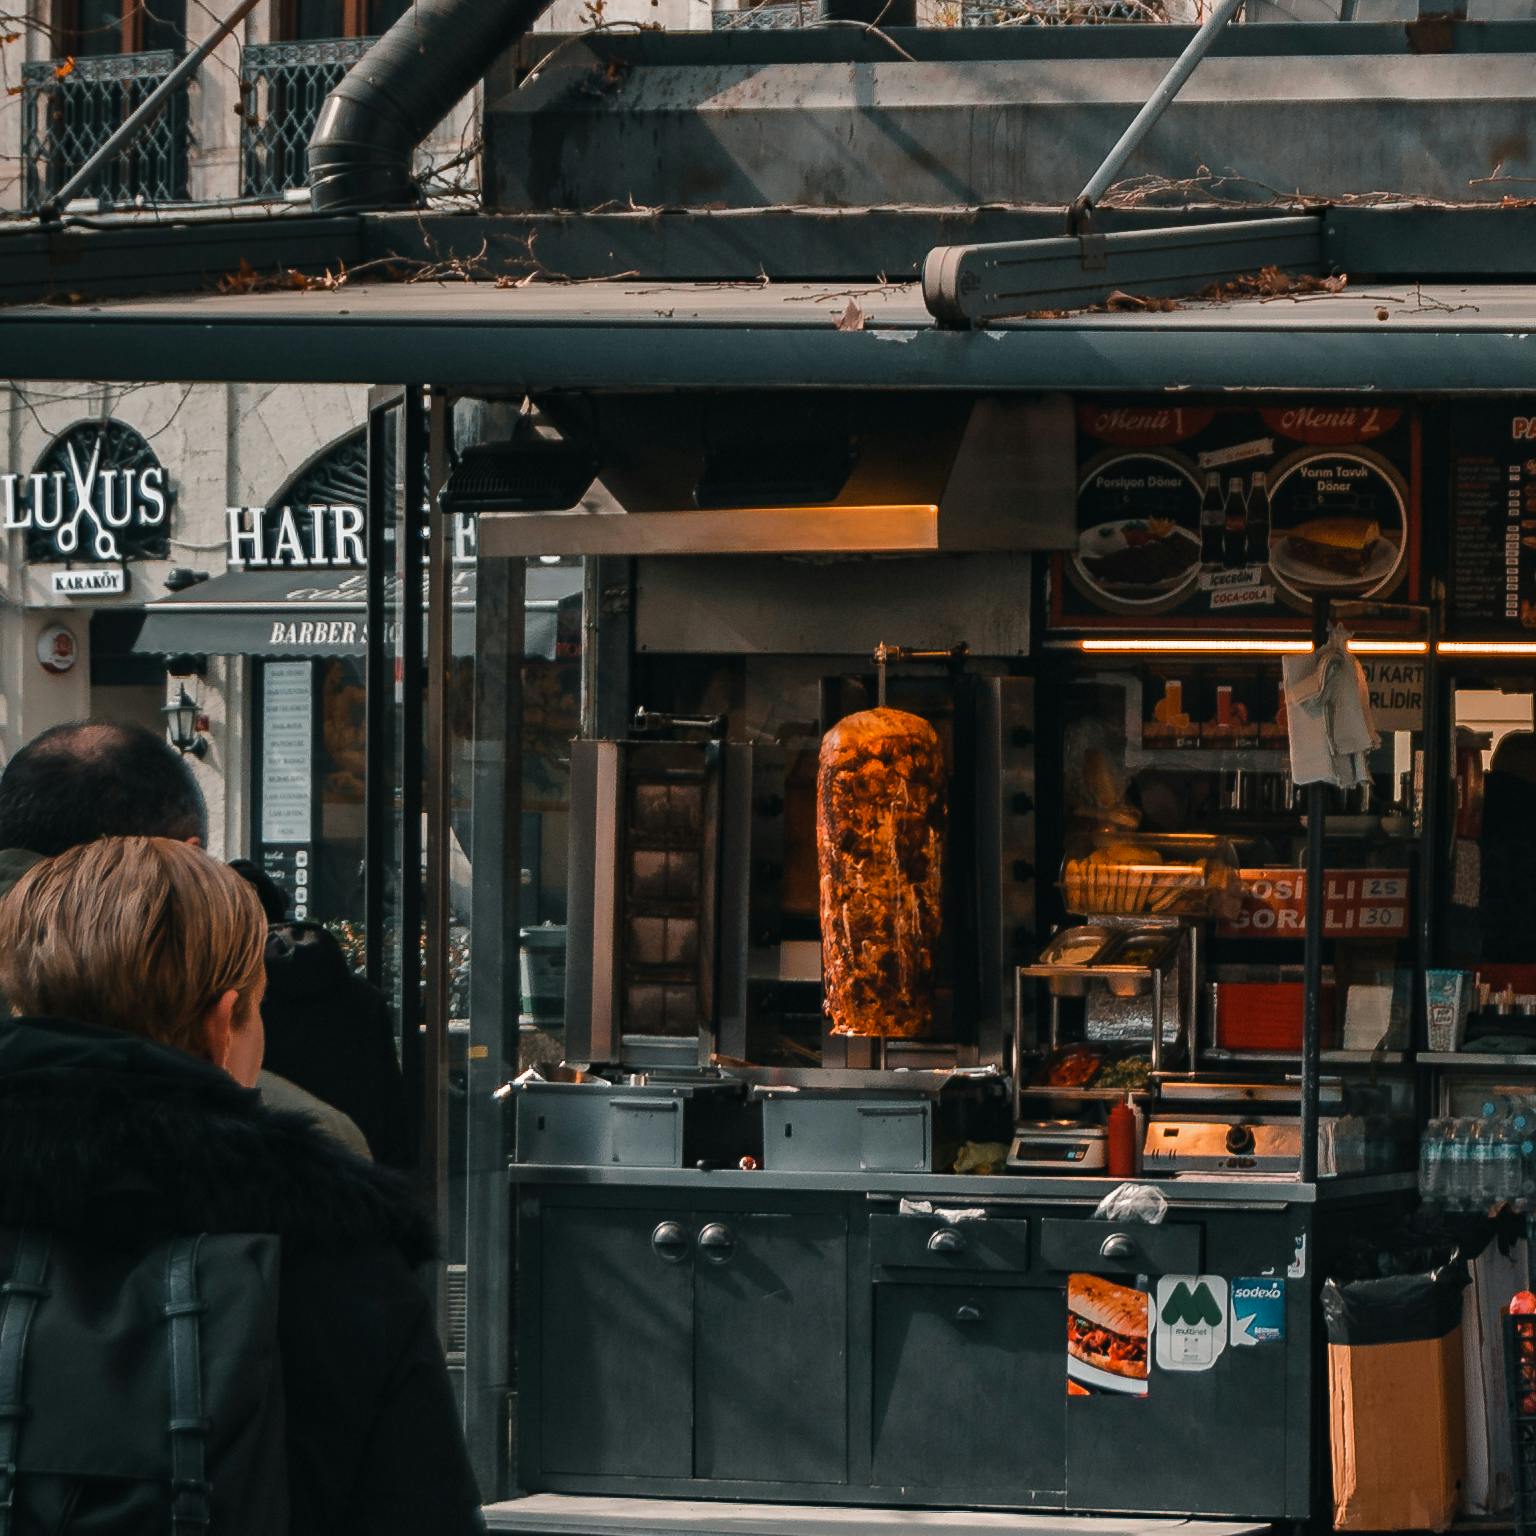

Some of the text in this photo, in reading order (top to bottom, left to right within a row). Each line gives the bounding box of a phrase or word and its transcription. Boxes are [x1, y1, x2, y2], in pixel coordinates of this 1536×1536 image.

[227, 505, 368, 565] HAIR
[55, 571, 120, 592] KARAKÖY
[1214, 589, 1268, 604] COCA-COLA
[270, 621, 358, 645] BARBER
[1379, 665, 1424, 683] KART
[1370, 880, 1399, 896] 25
[1235, 1285, 1281, 1299] sodexo
